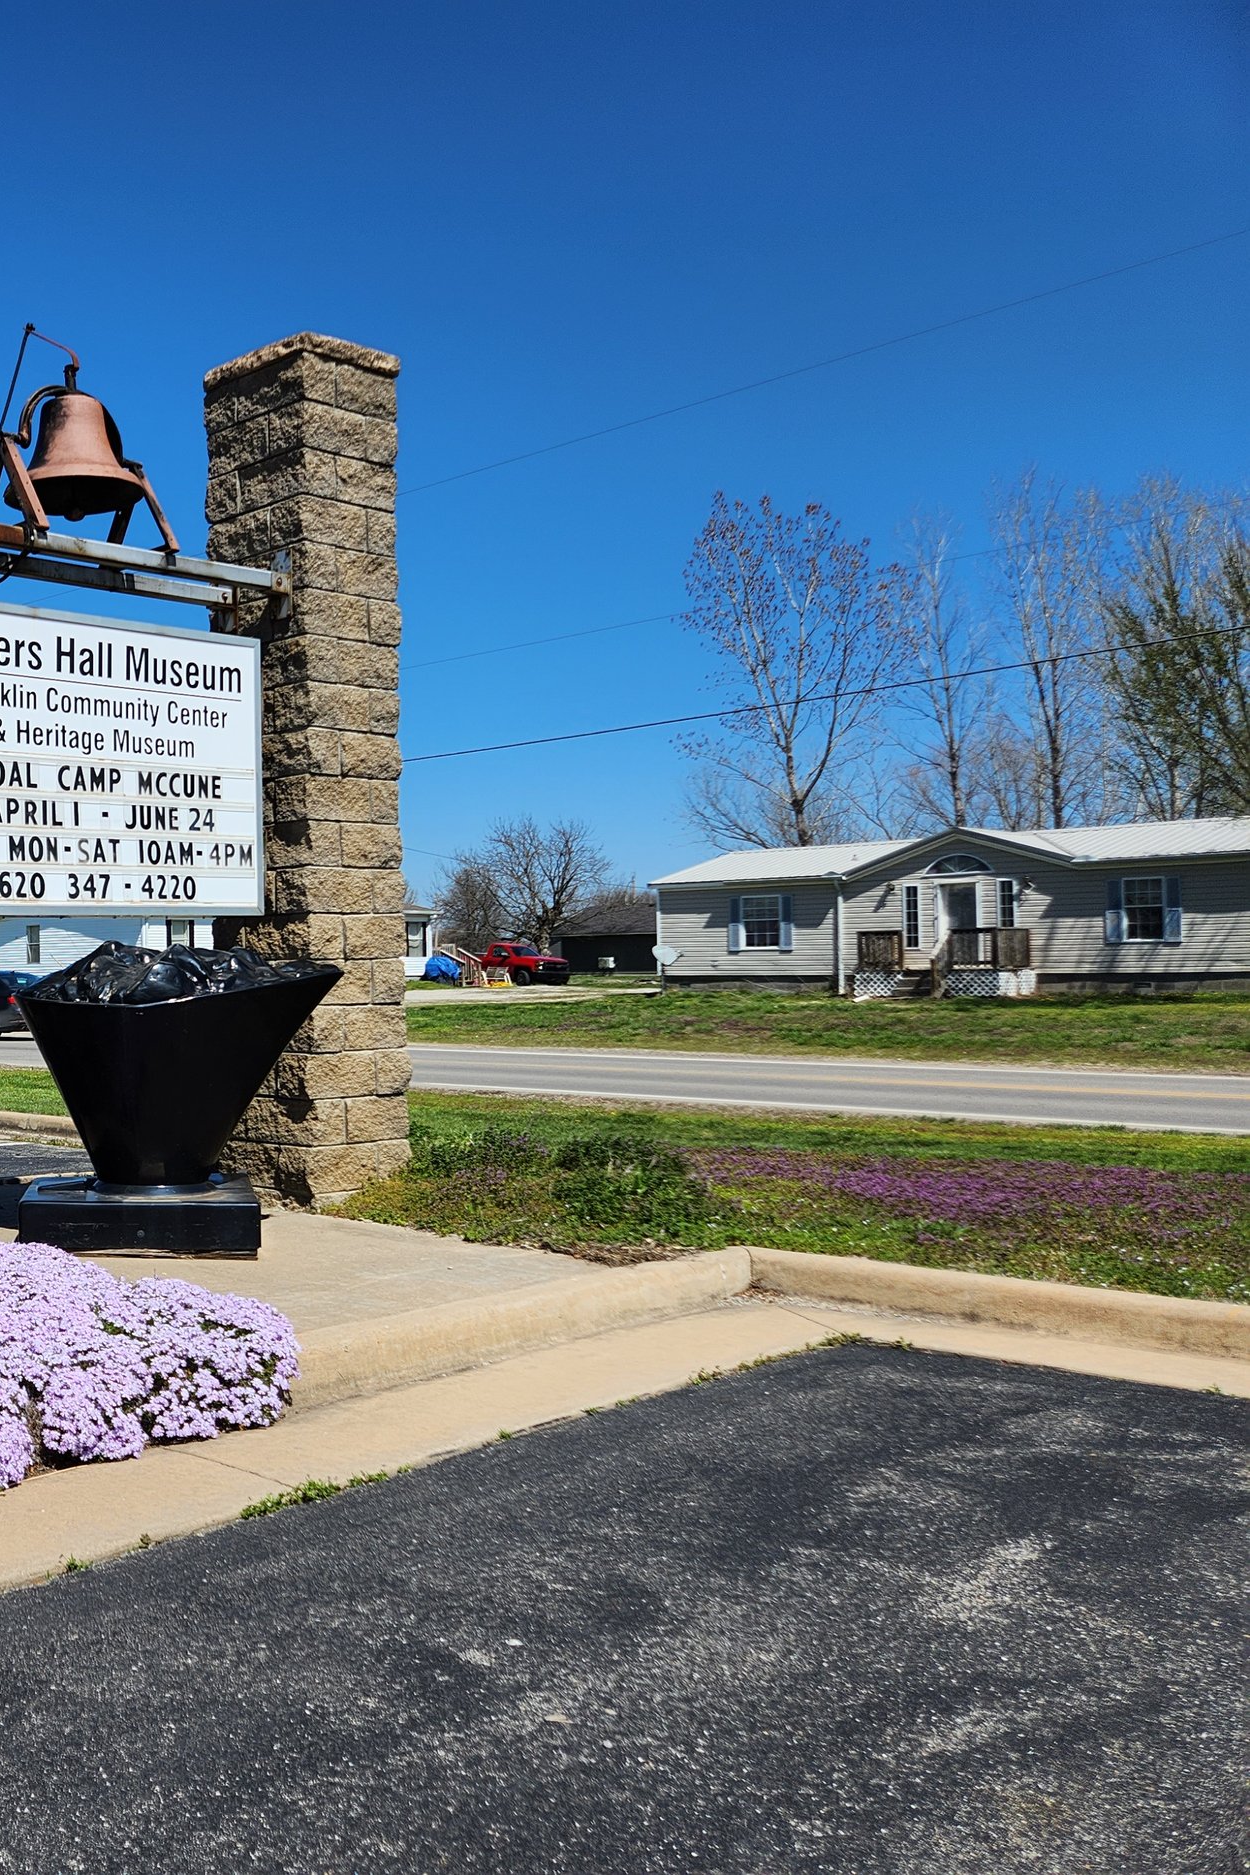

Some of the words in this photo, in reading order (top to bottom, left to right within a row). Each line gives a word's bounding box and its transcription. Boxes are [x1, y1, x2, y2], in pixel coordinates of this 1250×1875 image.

[56, 635, 113, 679] Hall
[125, 645, 242, 694] Museum
[46, 687, 160, 728] Community
[167, 700, 228, 729] Center
[16, 719, 105, 756] Heritage
[113, 728, 195, 759] Museum
[57, 764, 122, 794] CAMP
[137, 770, 222, 800] MCCUNE
[124, 804, 179, 831] JUNE
[188, 807, 215, 833] 24
[8, 835, 121, 864] MON-SAT
[138, 839, 253, 867] 10AM-4PM
[67, 872, 111, 900] 347
[141, 874, 197, 901] 4220
